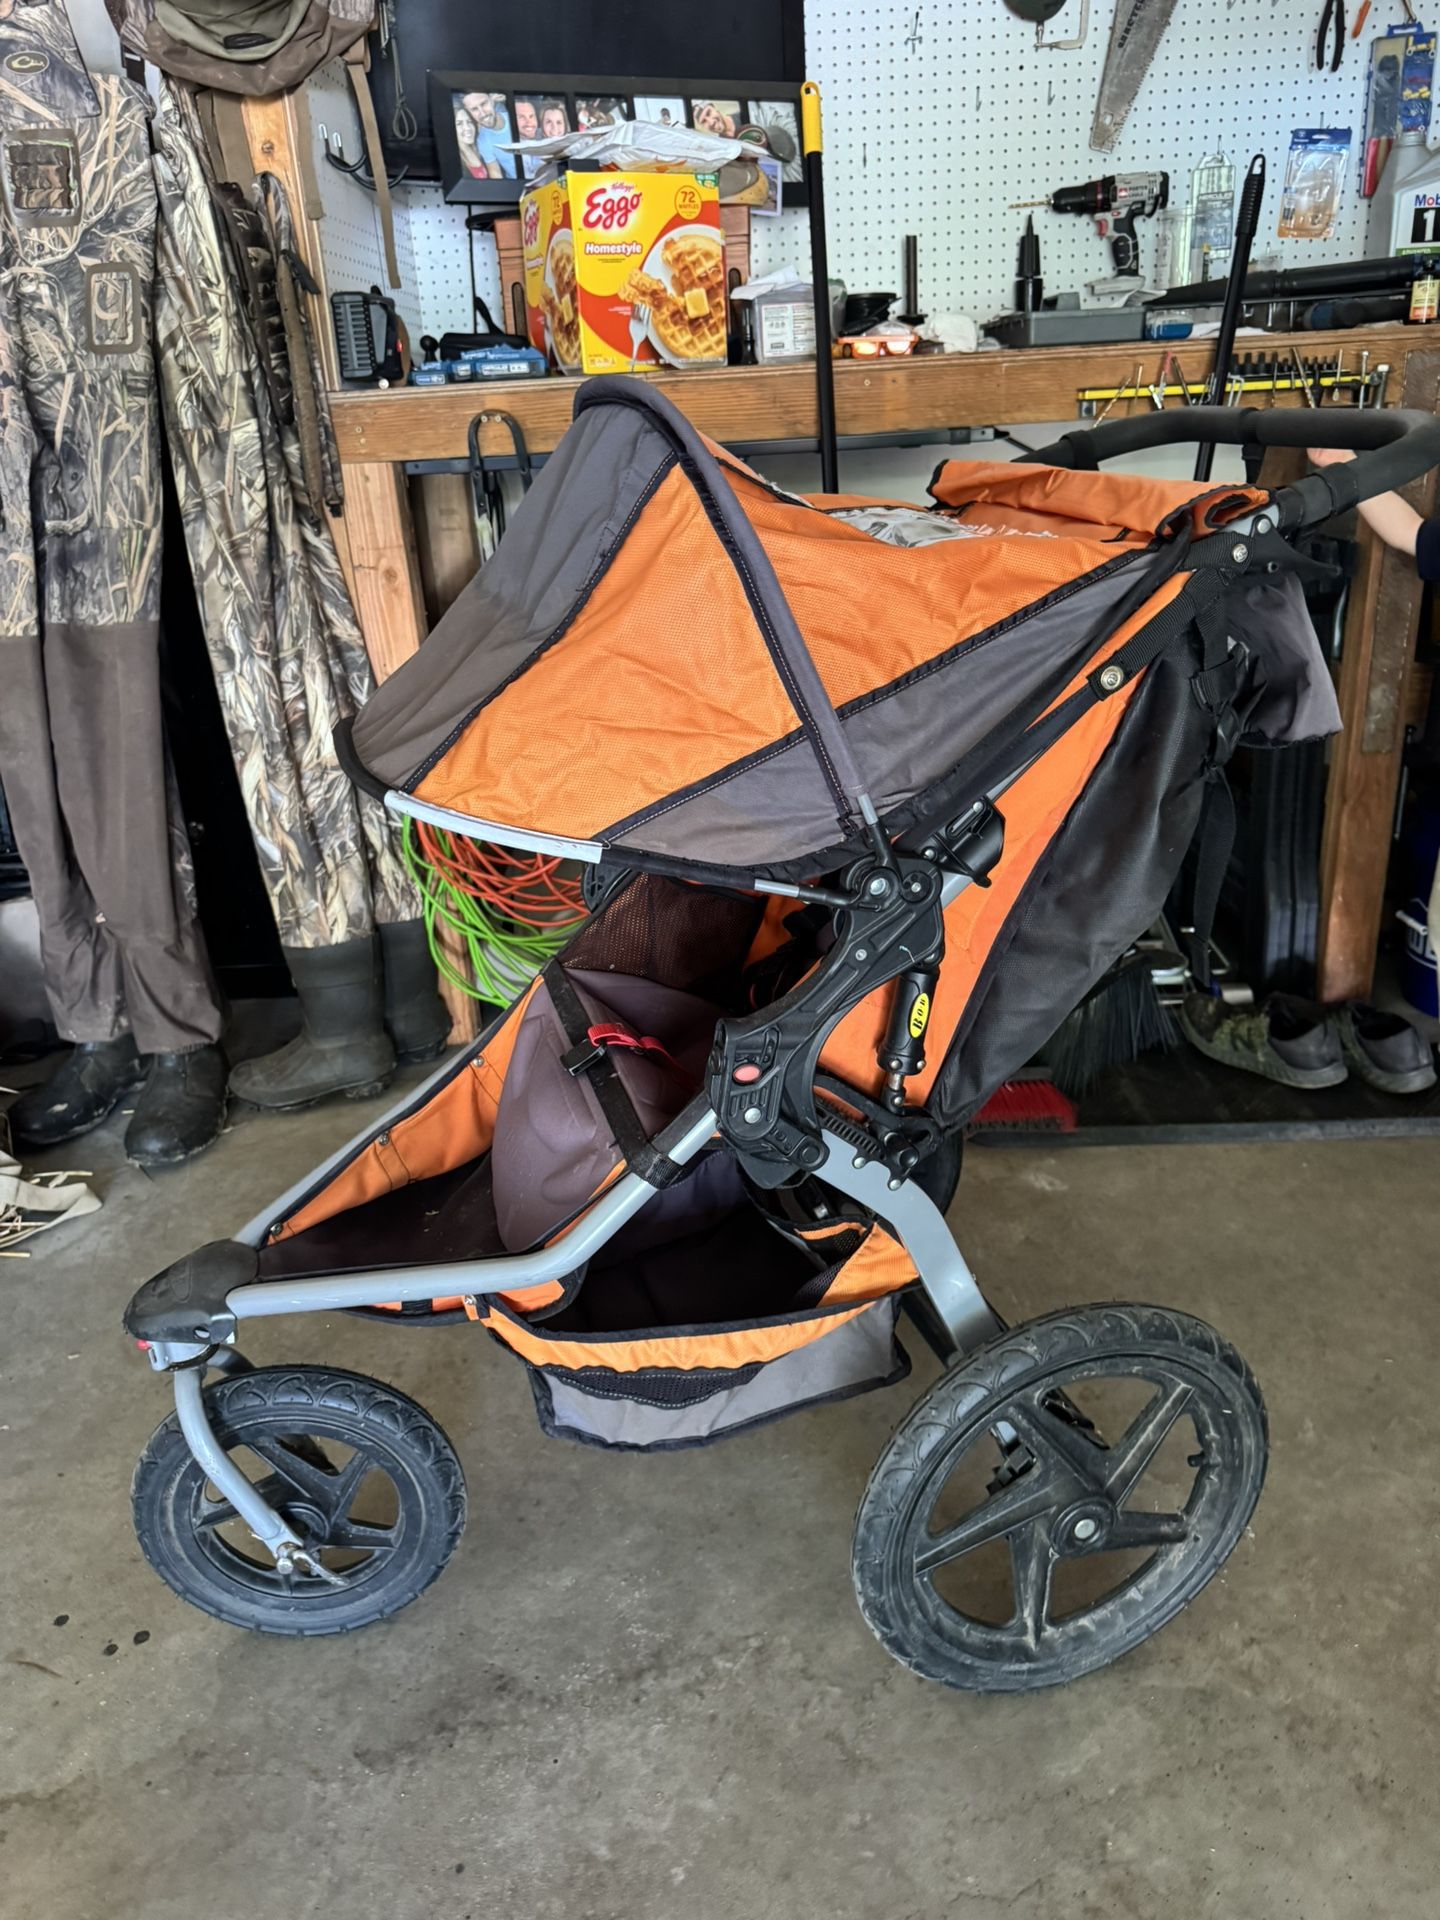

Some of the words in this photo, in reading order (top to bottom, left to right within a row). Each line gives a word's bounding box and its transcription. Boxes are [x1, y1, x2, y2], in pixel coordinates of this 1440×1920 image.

[583, 188, 642, 230] Eggo
[681, 191, 696, 203] 72
[1423, 209, 1436, 242] 1
[585, 241, 643, 256] Homestyle
